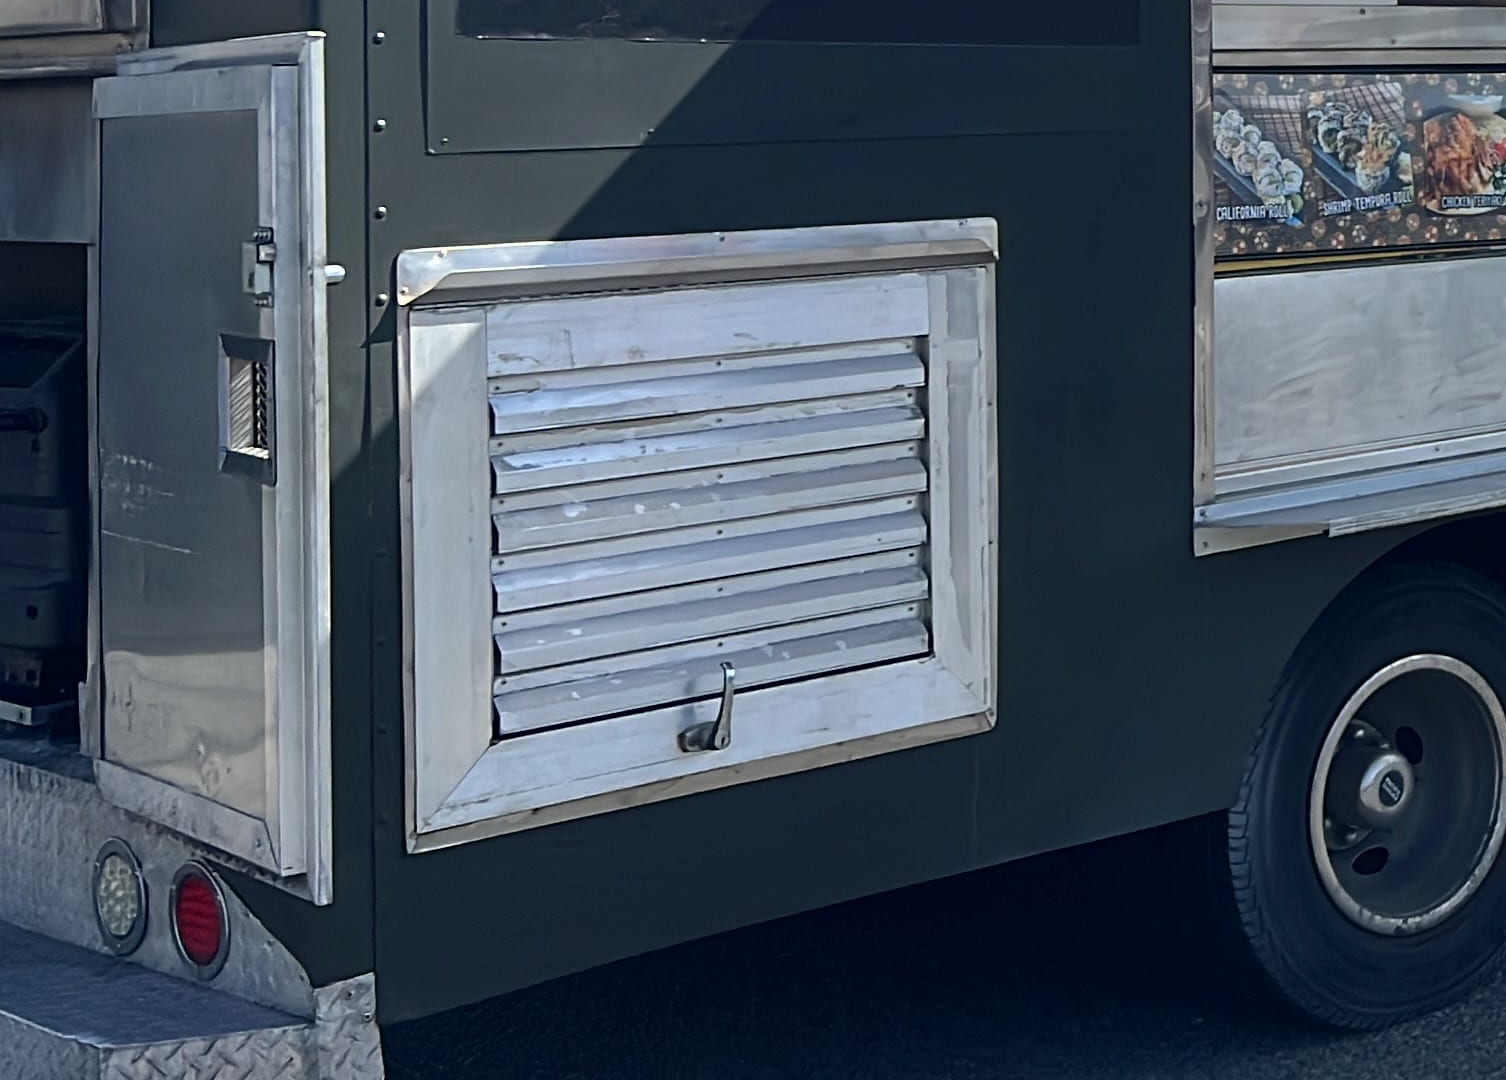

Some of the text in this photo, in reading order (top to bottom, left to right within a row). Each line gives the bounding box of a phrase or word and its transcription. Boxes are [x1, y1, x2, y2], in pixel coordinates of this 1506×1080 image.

[1322, 190, 1412, 216] SHRIMP TEMPURA ROLL
[1442, 195, 1502, 208] CHICKEN TERIYAKI
[1216, 204, 1289, 221] CALIFORNIA ROLL
